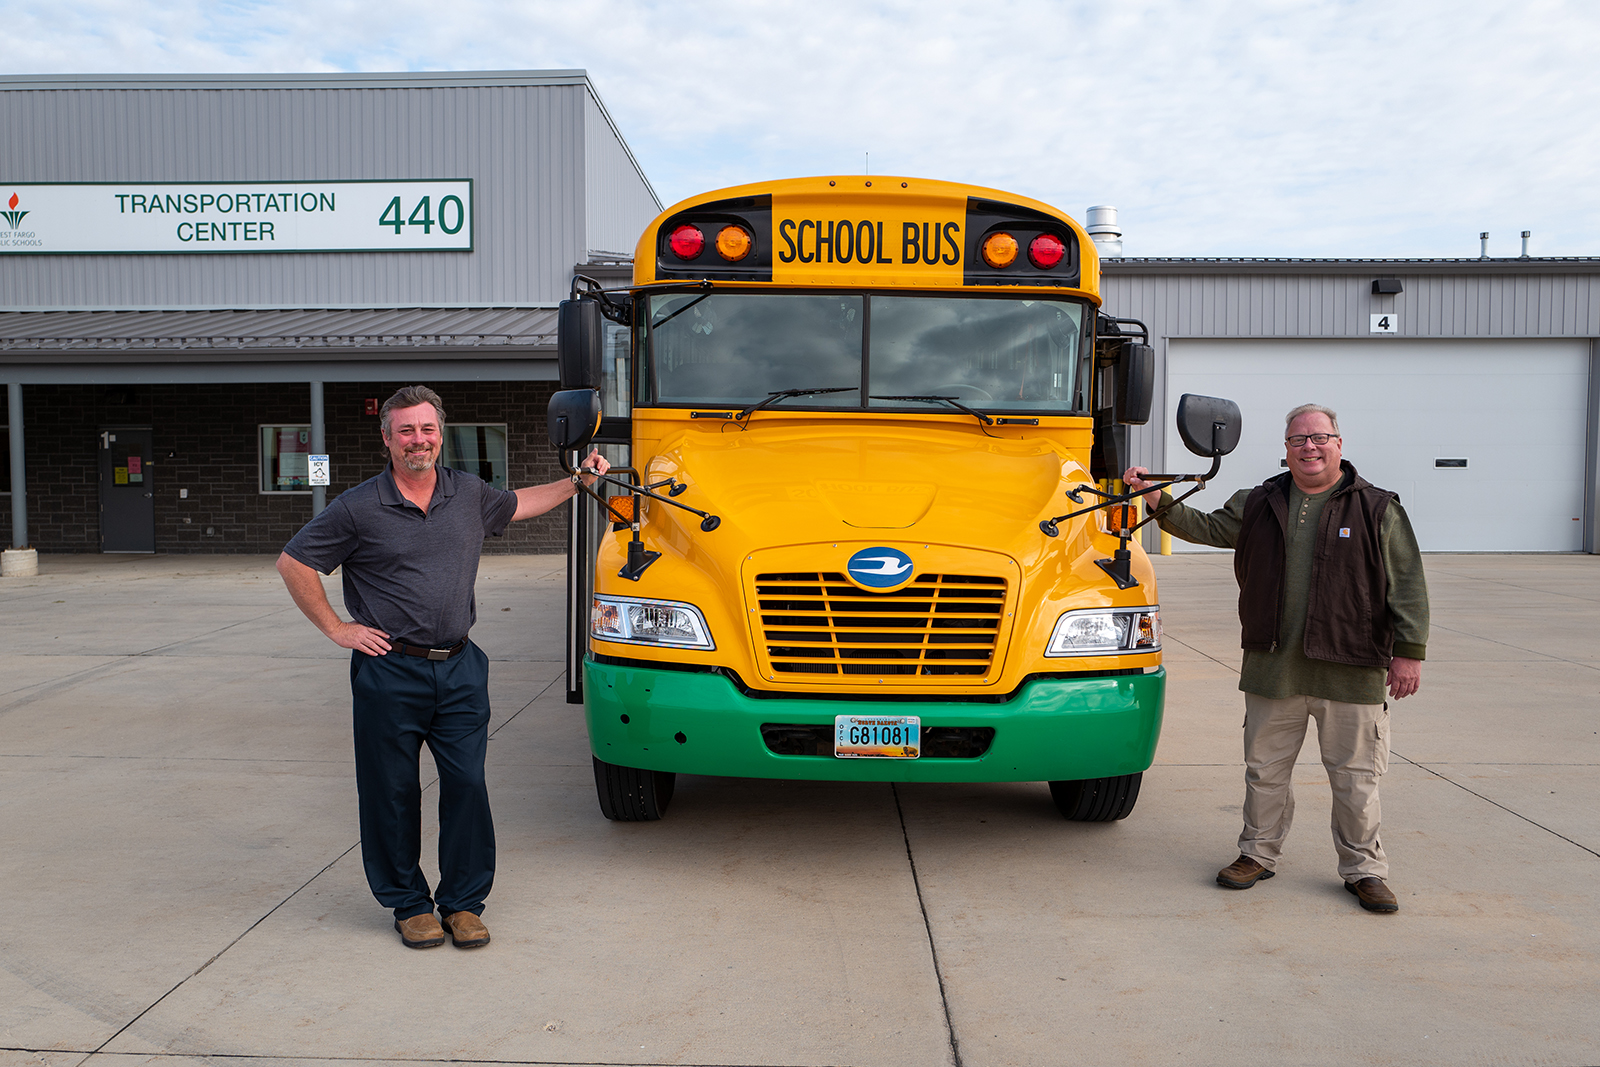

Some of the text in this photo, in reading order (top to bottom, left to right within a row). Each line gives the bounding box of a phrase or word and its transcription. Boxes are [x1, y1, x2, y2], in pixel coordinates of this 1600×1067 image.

[115, 192, 336, 214] TRANSPORTATION
[379, 194, 465, 235] 440
[14, 231, 36, 239] FARGO
[177, 221, 275, 242] CENTER
[12, 239, 43, 247] SCHOOLS
[778, 219, 960, 266] SCHOOL BUS
[1378, 316, 1390, 330] 4
[100, 431, 109, 449] 1
[850, 726, 909, 746] G81081
